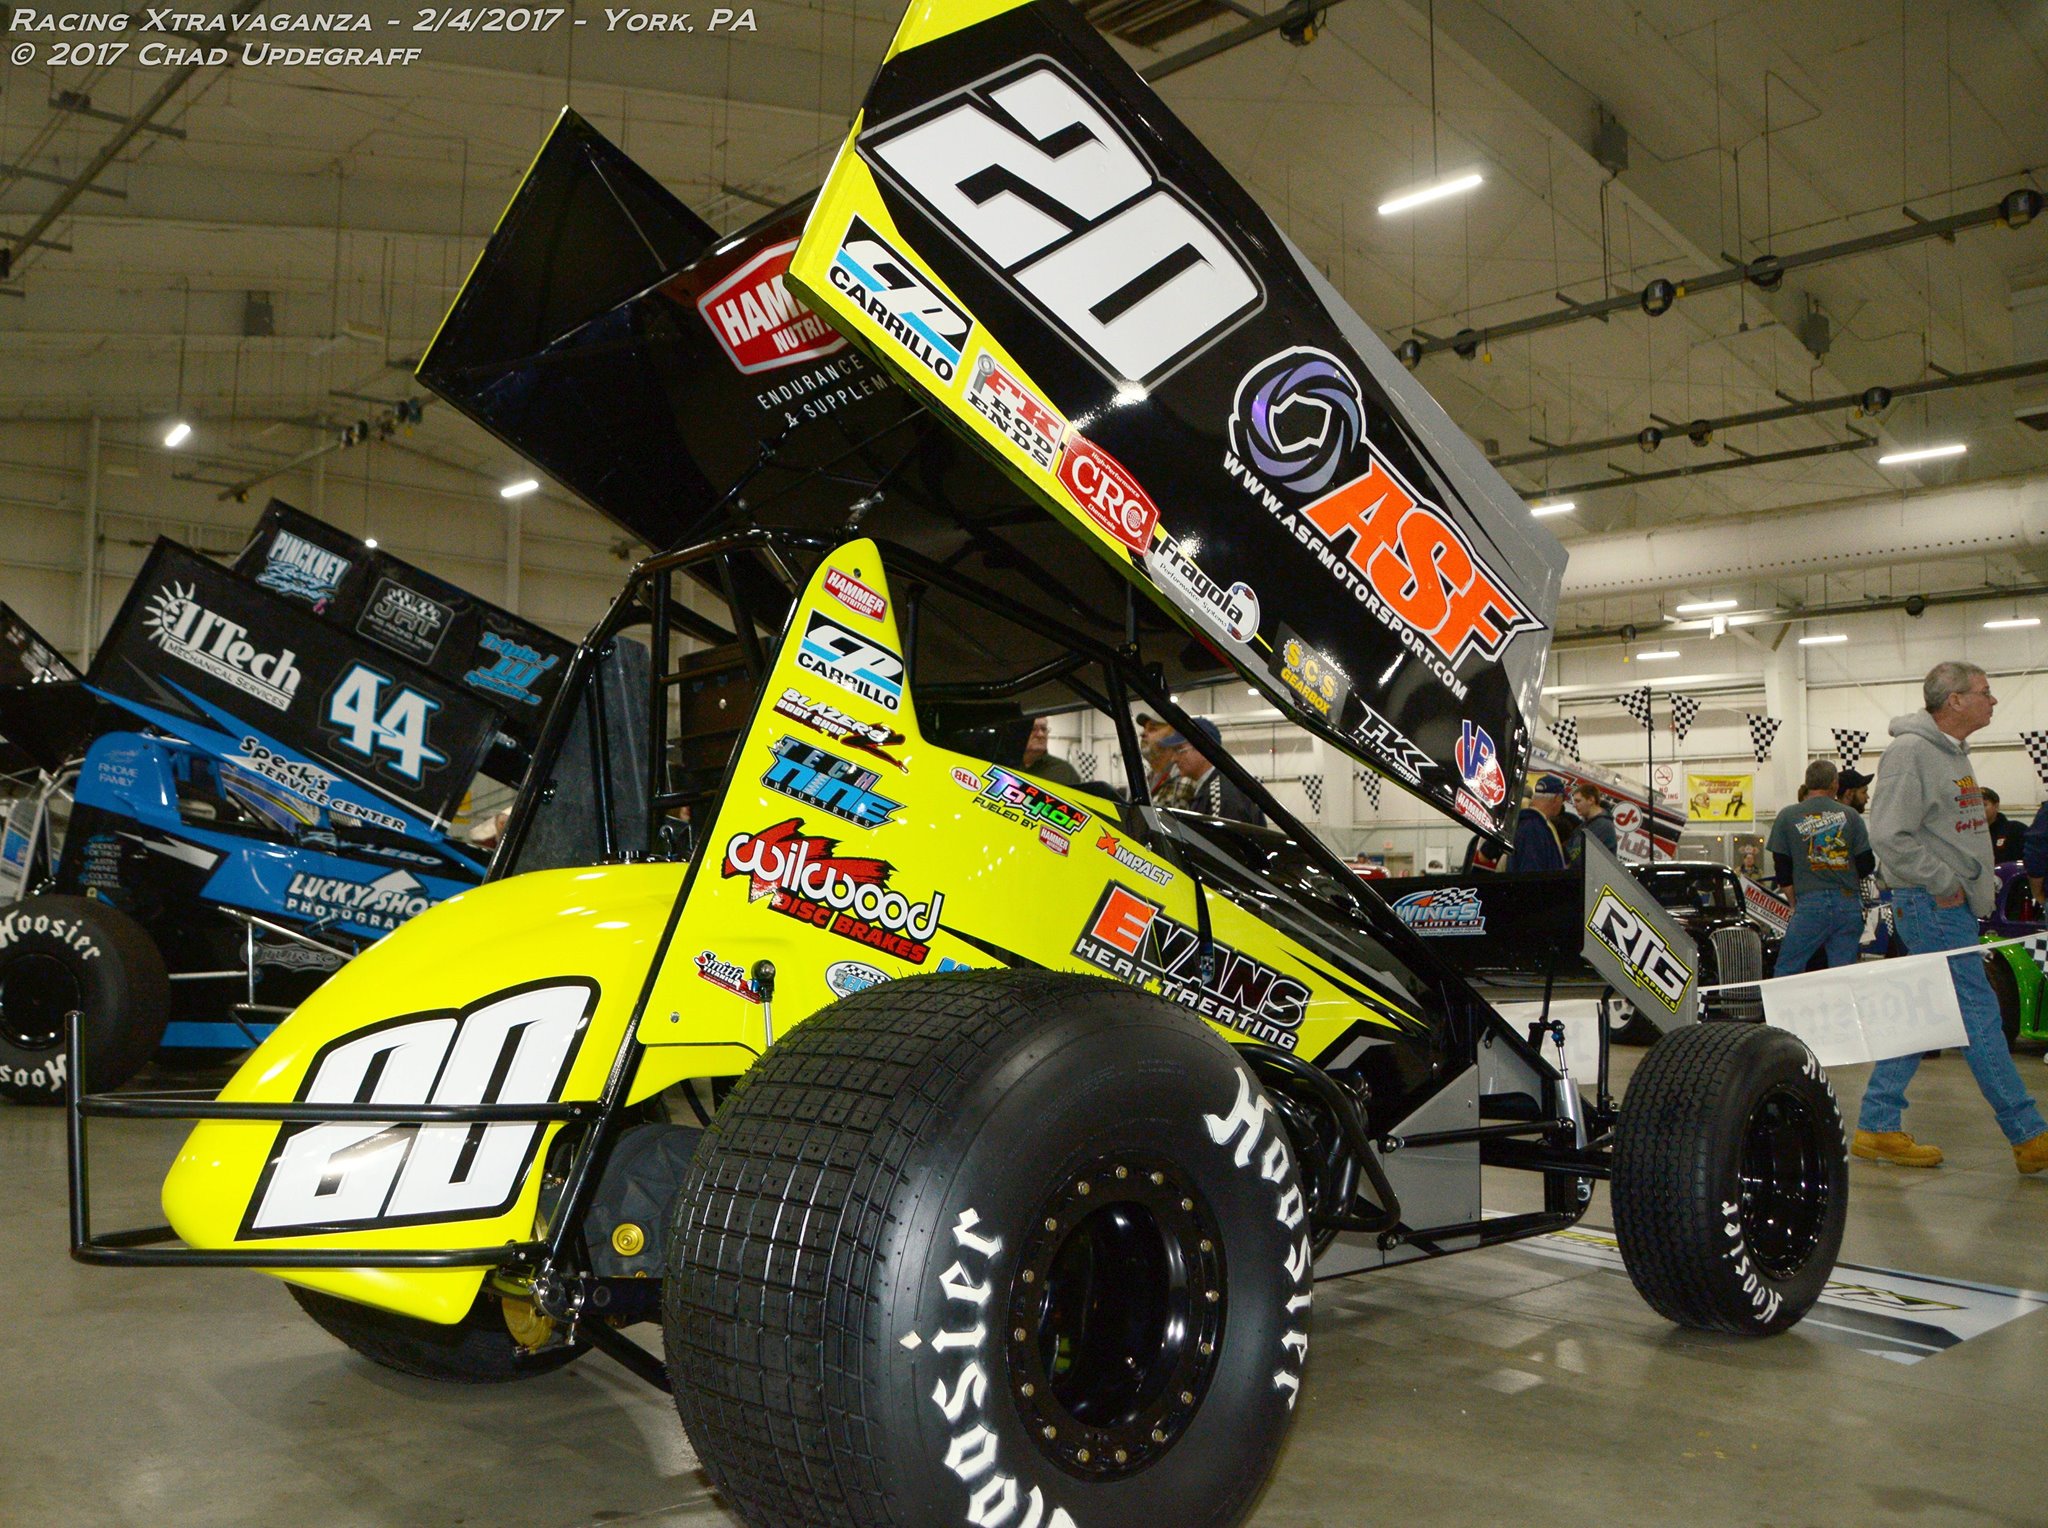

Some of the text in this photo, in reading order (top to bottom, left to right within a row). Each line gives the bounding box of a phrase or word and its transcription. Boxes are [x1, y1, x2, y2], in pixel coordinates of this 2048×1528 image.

[873, 69, 1258, 381] 20
[716, 274, 812, 348] HAM
[772, 315, 833, 354] NUTRI
[829, 265, 954, 382] CARRILLO
[757, 353, 864, 410] ENDURANCE
[785, 373, 897, 428] & SUPPLEM
[981, 366, 1062, 444] FK
[967, 392, 1050, 468] ENDS
[991, 396, 1052, 455] ROD
[1072, 455, 1148, 538] CRC
[1087, 503, 1116, 531] Chemicals
[269, 531, 348, 585] PINCKNEY
[1159, 536, 1243, 625] Fragola
[1222, 450, 1469, 701] WWW.ASFMOTORSPORT.COM
[1301, 456, 1522, 661] ASF
[374, 599, 441, 637] JRT
[827, 571, 885, 613] HAMMER
[837, 591, 872, 615] NUTRITION
[1160, 562, 1227, 628] Performance Systems
[168, 642, 286, 708] MECHANICAL SERVICES
[797, 652, 899, 711] CARRILLO
[1280, 667, 1331, 716] GEARBOX
[1286, 641, 1337, 699] SCS
[329, 664, 447, 780] 44
[776, 698, 848, 738] BODY SHOP
[781, 687, 891, 742] BLAZER'S
[241, 736, 330, 791] Speck's
[777, 736, 876, 790] TECH
[1462, 719, 1496, 781] VP
[254, 761, 407, 833] SERVICE CENTER
[764, 779, 871, 827] INDUSTRIES
[954, 770, 979, 790] BELL
[987, 768, 1081, 829] Taylor
[1026, 786, 1085, 822] RYAN
[972, 796, 1038, 830] FUELED BY
[1040, 827, 1069, 850] HAMMER
[286, 898, 410, 930] PHOTOGRA
[288, 873, 372, 909] LUCKY
[728, 833, 945, 941] wilwood
[1396, 902, 1479, 921] WINGS
[0, 910, 101, 960] Hoosier
[772, 893, 930, 963] DISC BRAKES
[1091, 885, 1312, 1028] EVANS
[1591, 895, 1690, 1000] RTG
[694, 951, 745, 982] Smith
[1075, 937, 1297, 1050] HEAT TREATING
[1631, 963, 1678, 1009] GRAPHICS
[252, 985, 592, 1230] 20
[1721, 1201, 1784, 1324] Hoosier
